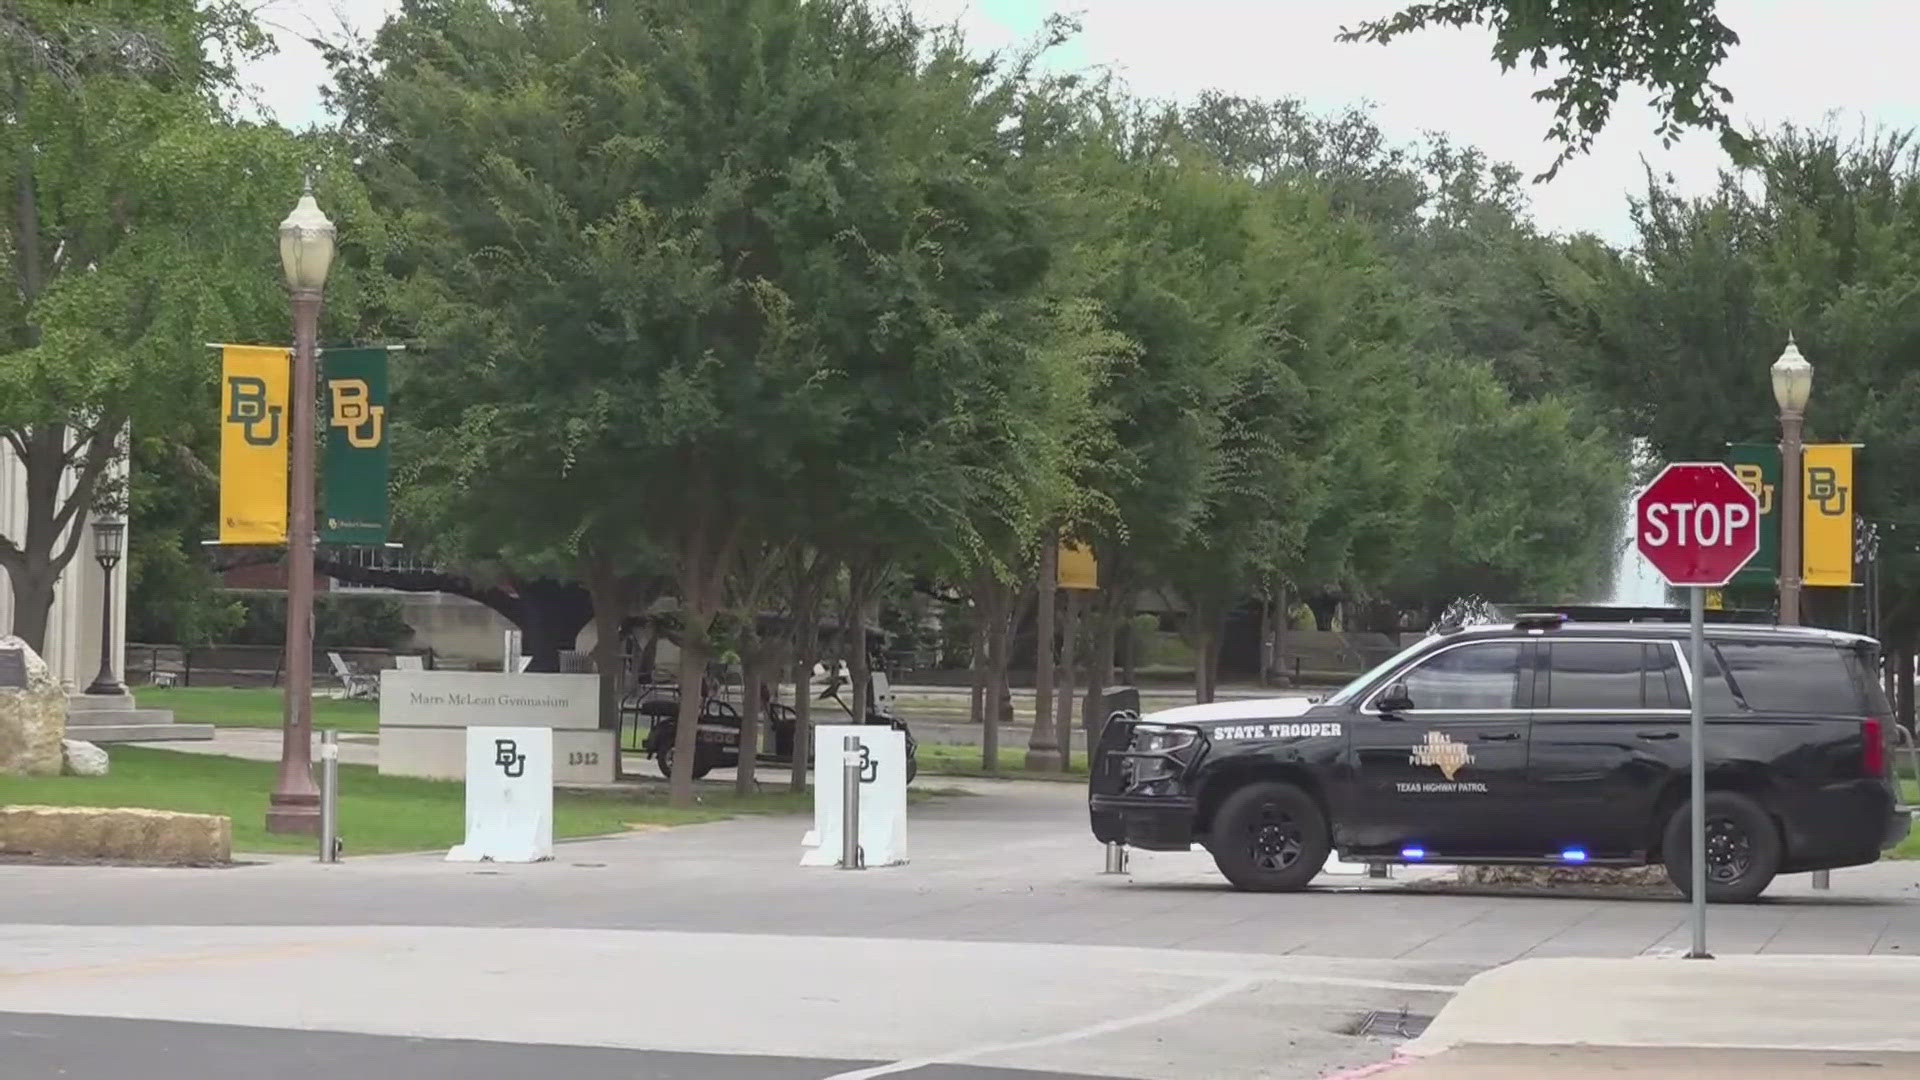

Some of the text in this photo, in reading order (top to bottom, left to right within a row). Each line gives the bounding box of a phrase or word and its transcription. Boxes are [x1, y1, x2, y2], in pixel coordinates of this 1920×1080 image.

[227, 376, 283, 446] BU
[328, 378, 384, 448] BU
[1808, 467, 1848, 516] BU
[1644, 502, 1750, 546] STOP
[448, 692, 495, 706] McLean
[498, 694, 569, 708] Gymnasium
[1214, 722, 1342, 740] STATE TROOPER
[1423, 733, 1451, 745] TEXAS
[495, 739, 526, 778] BU
[568, 752, 599, 766] 1312
[1409, 755, 1441, 766] PUBLIC
[1396, 782, 1488, 792] TEXAS HIGHWAY PATROL
